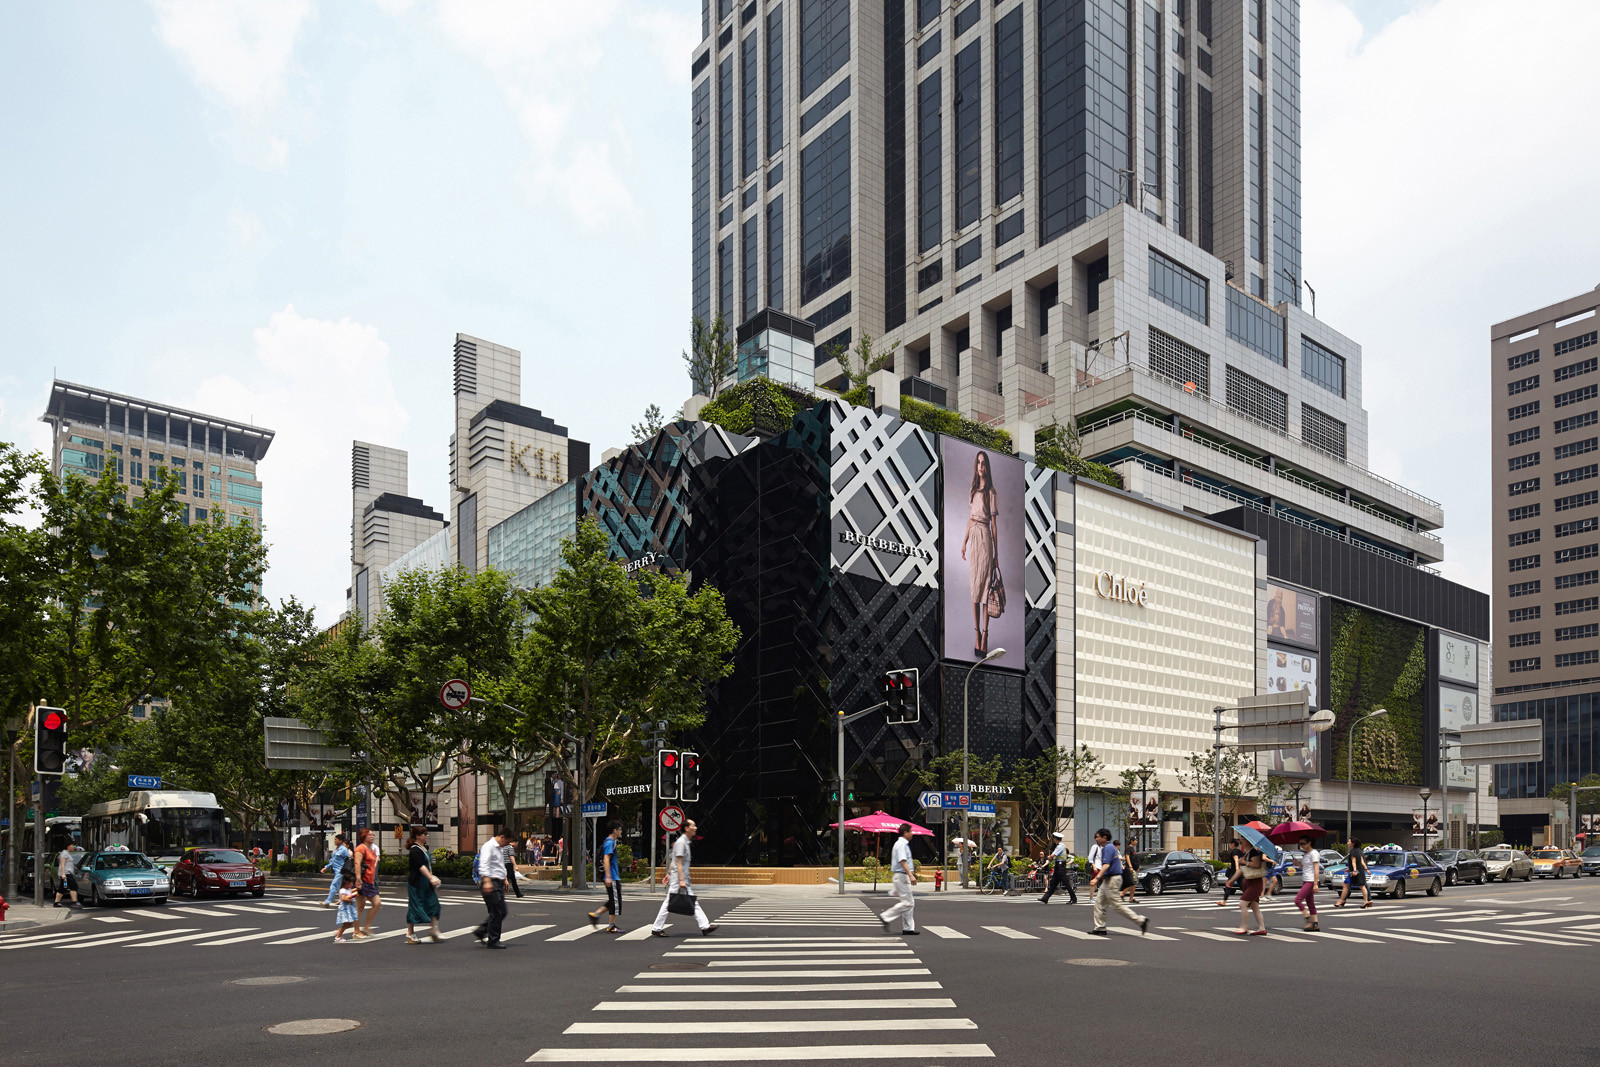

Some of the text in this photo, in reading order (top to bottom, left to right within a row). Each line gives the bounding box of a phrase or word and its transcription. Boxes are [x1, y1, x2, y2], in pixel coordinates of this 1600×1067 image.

[511, 440, 564, 482] K11
[844, 530, 929, 559] BURBERRY
[1096, 570, 1148, 606] Chloé
[606, 784, 652, 796] BURBERRY
